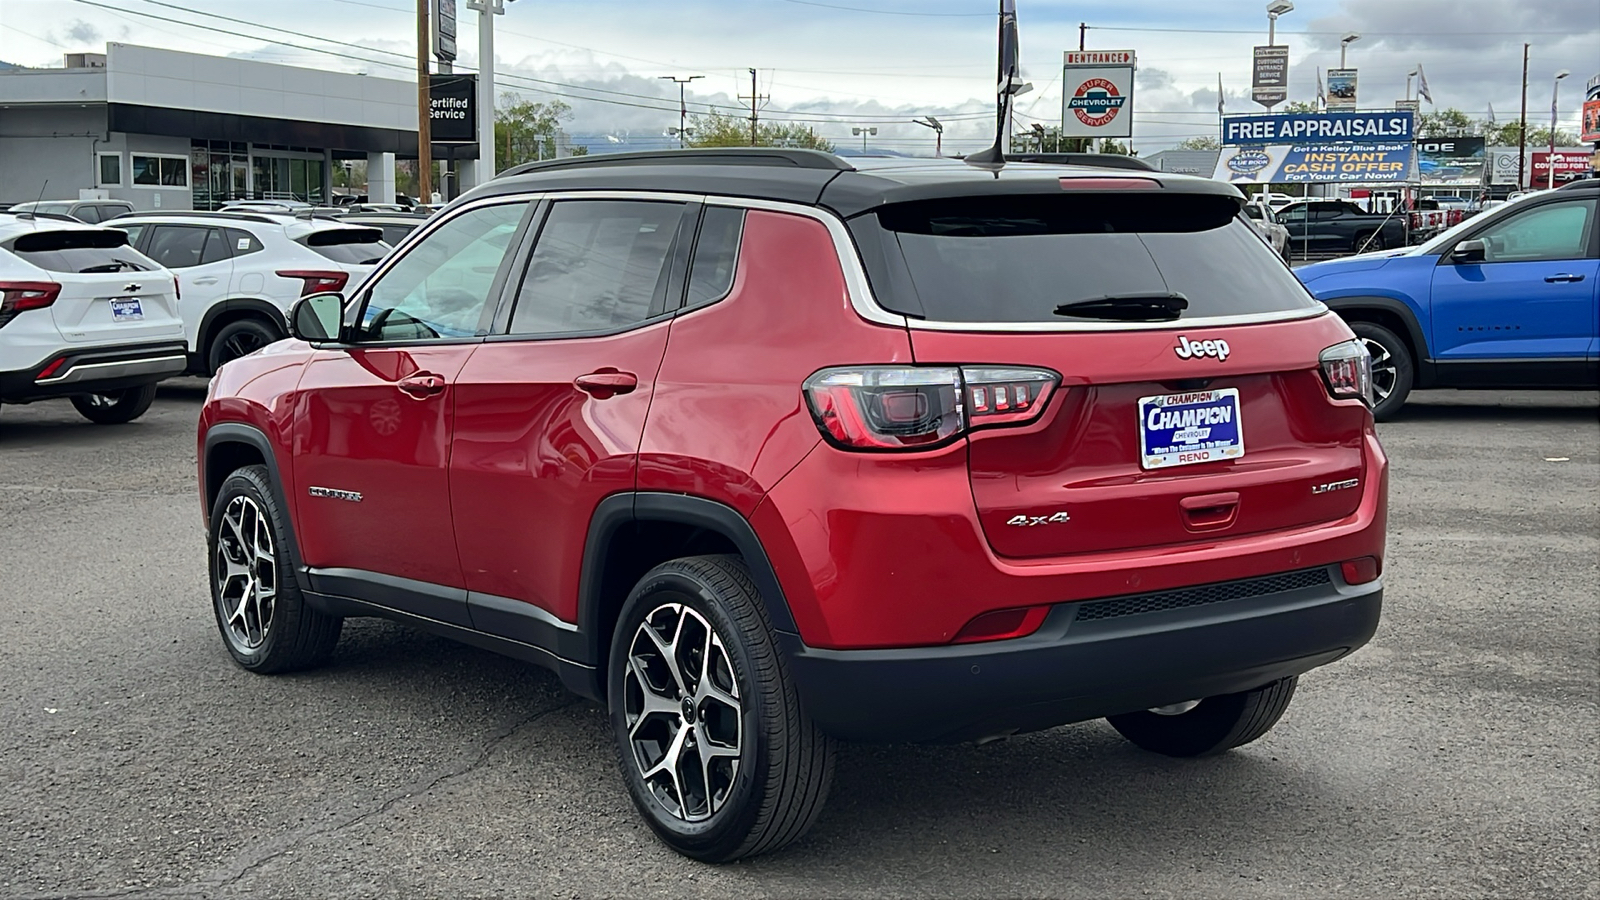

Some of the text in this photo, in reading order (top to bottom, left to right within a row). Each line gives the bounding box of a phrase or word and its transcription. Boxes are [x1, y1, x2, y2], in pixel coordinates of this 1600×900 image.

[1075, 53, 1122, 63] ENTRANCE
[1080, 80, 1113, 92] SUPER
[430, 108, 465, 119] Service
[1077, 110, 1115, 126] SERVICE
[1228, 118, 1407, 139] FREE APPRAISALS!
[1320, 145, 1350, 153] Kelley
[1304, 152, 1388, 162] INSTANT
[1284, 162, 1404, 173] CASH OFFER
[1174, 335, 1231, 361] Jeep
[1166, 392, 1213, 405] CHAMPION
[1147, 406, 1231, 431] CHAMPION
[1175, 430, 1208, 440] CHEVROLET
[1179, 451, 1210, 463] RENO
[1006, 511, 1071, 527] 4x4
